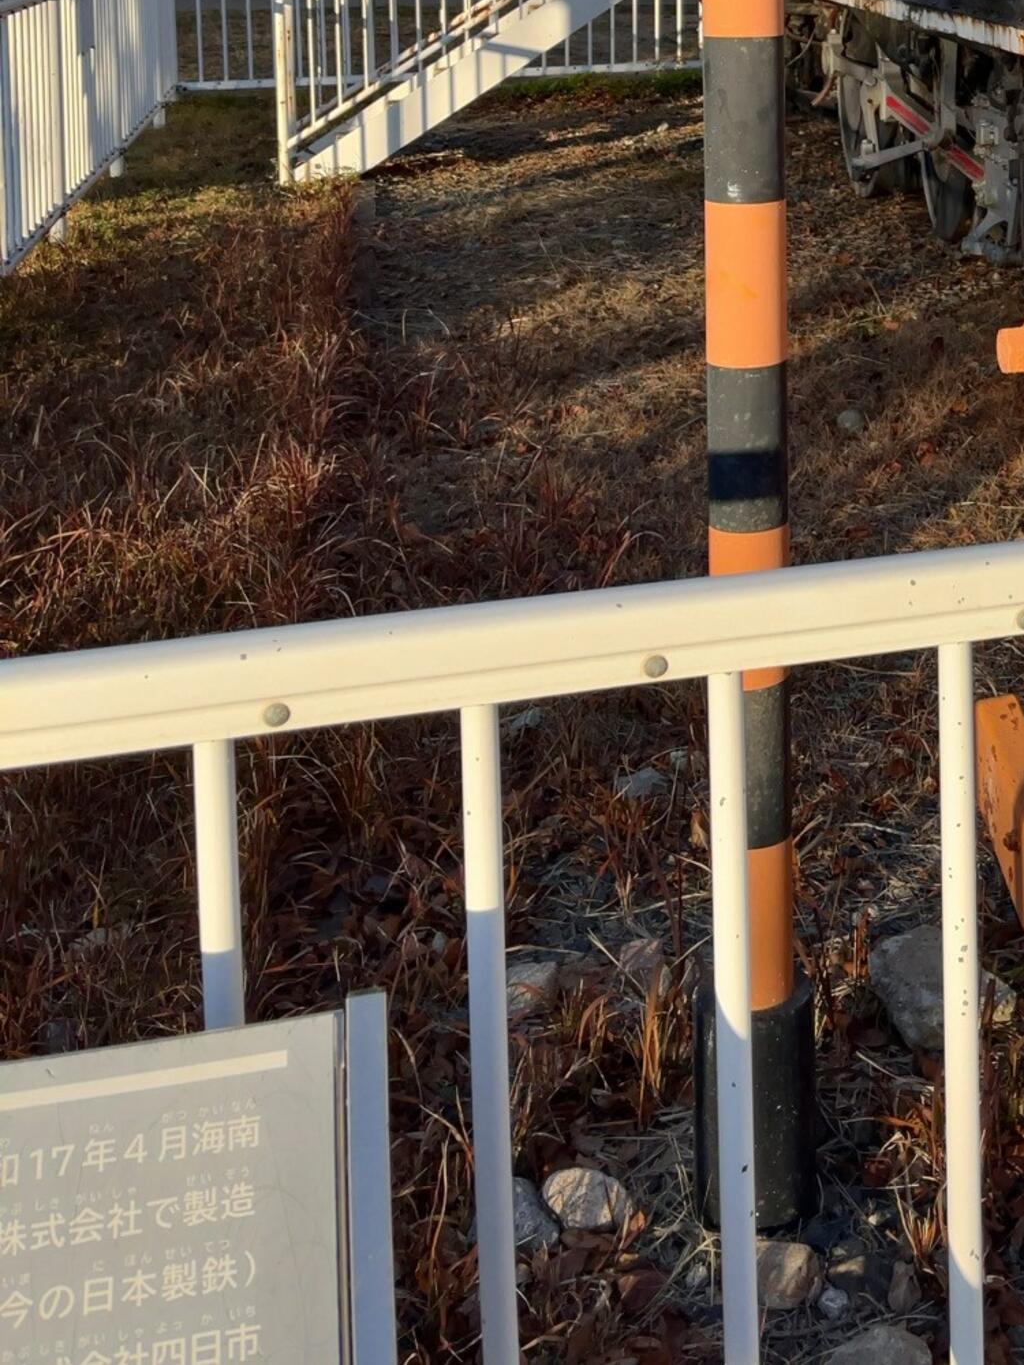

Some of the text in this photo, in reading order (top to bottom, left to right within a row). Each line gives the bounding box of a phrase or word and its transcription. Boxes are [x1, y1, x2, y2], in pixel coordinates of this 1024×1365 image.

[0, 1181, 256, 1256] 株式会社で製造
